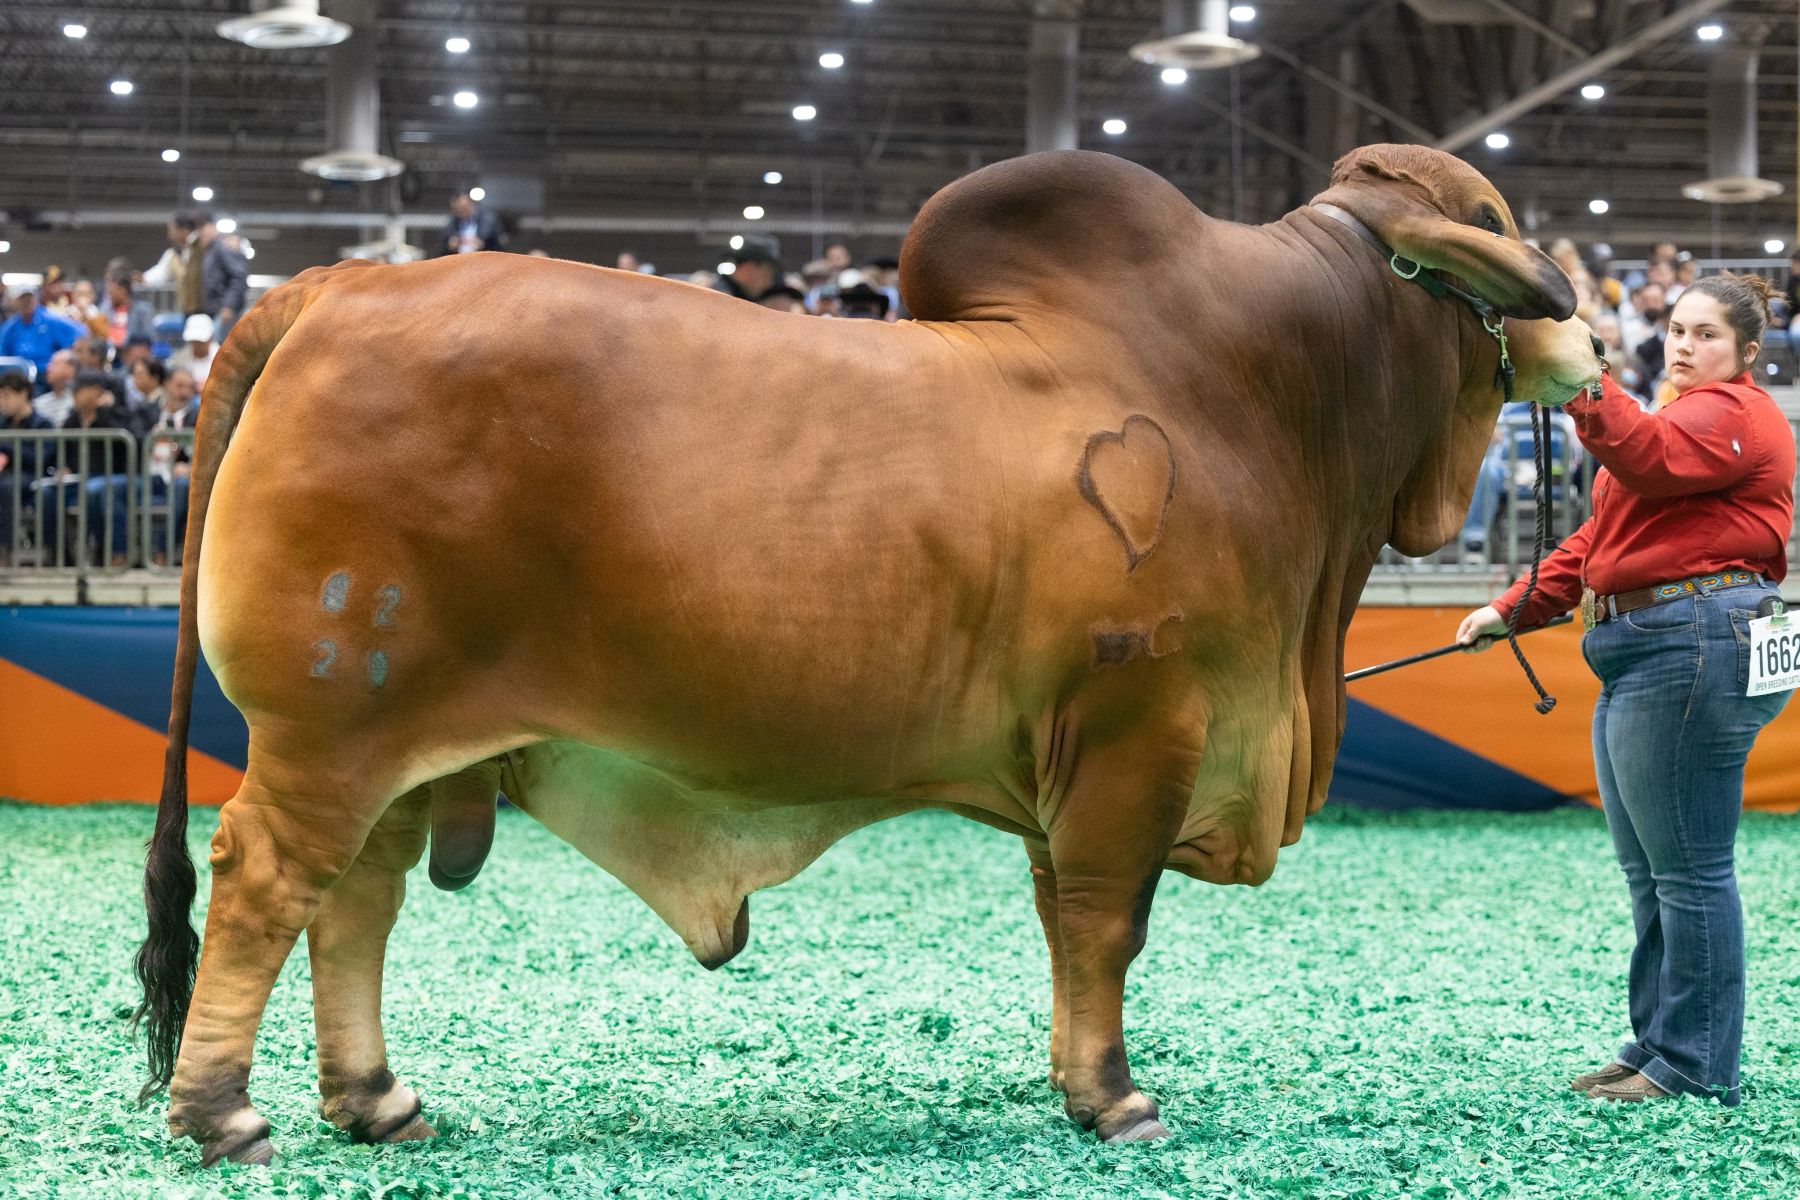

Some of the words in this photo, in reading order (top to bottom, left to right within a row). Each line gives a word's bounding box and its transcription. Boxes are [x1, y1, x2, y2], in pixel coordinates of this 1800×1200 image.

[1756, 633, 1800, 678] 1662
[1755, 682, 1767, 691] OPEN
[1768, 678, 1787, 689] BREEDING
